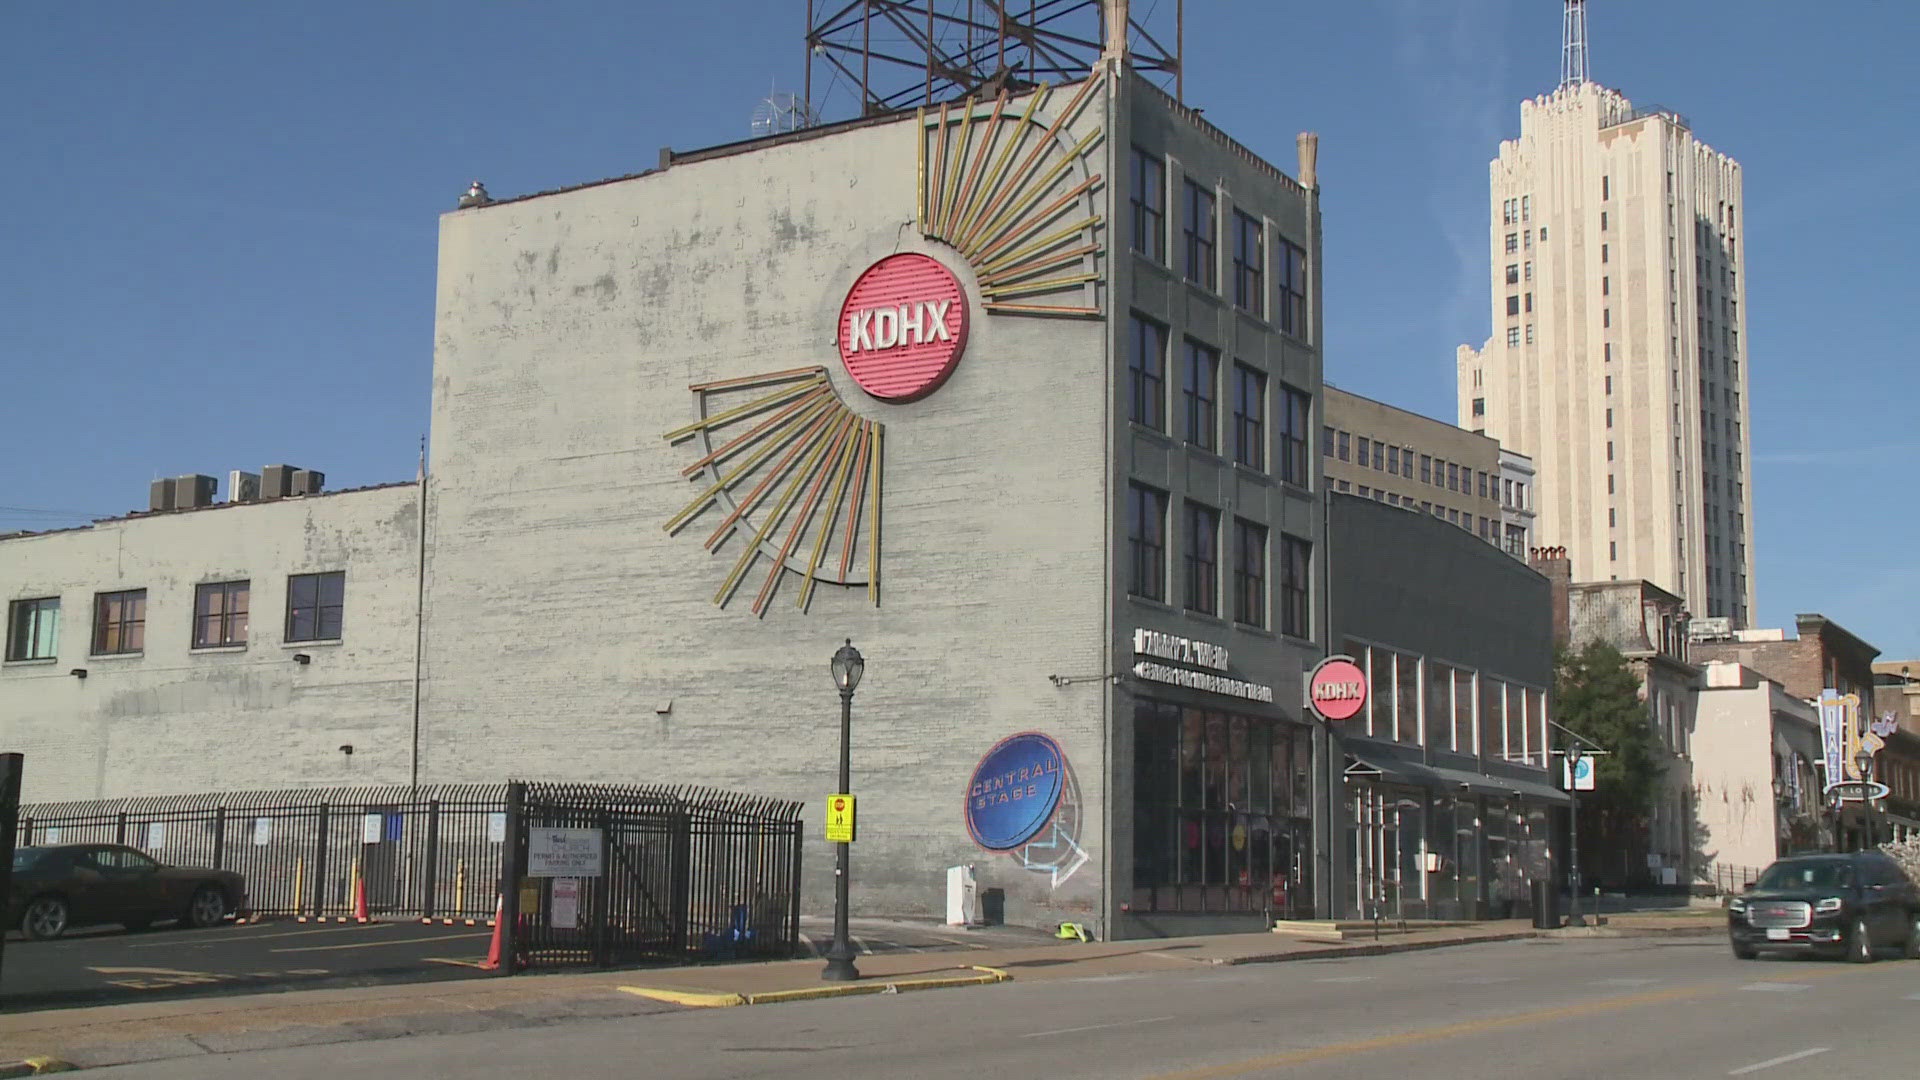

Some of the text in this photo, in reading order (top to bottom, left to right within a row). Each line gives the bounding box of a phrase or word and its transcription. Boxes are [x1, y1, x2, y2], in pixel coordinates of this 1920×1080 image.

[850, 300, 952, 352] KDHX
[1316, 682, 1360, 700] KDHX
[972, 758, 1058, 797] CENTRAL
[976, 784, 1037, 809] STAGE
